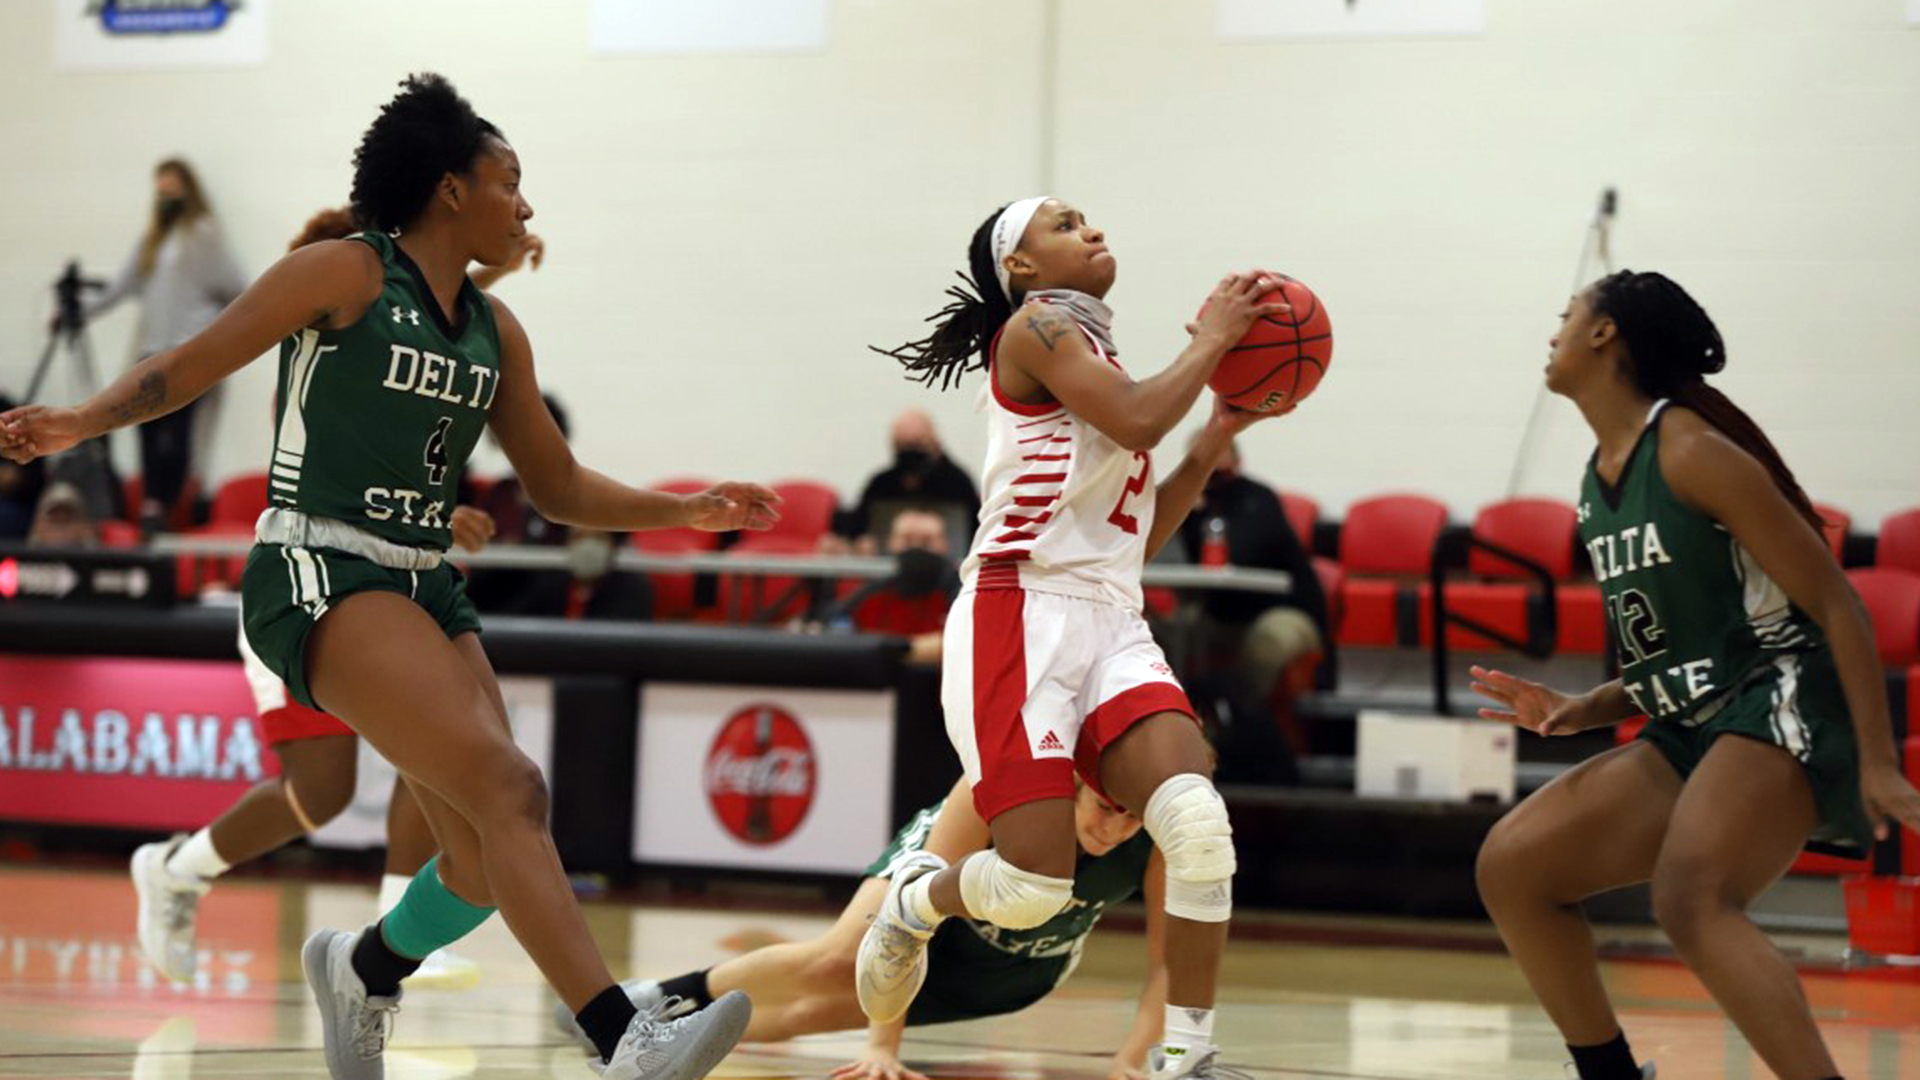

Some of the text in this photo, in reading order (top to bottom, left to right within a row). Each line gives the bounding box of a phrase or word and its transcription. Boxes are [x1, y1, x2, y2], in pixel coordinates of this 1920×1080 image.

[424, 416, 453, 486] 4
[364, 486, 454, 530] STA
[1107, 449, 1151, 535] 2
[1608, 588, 1667, 669] 12
